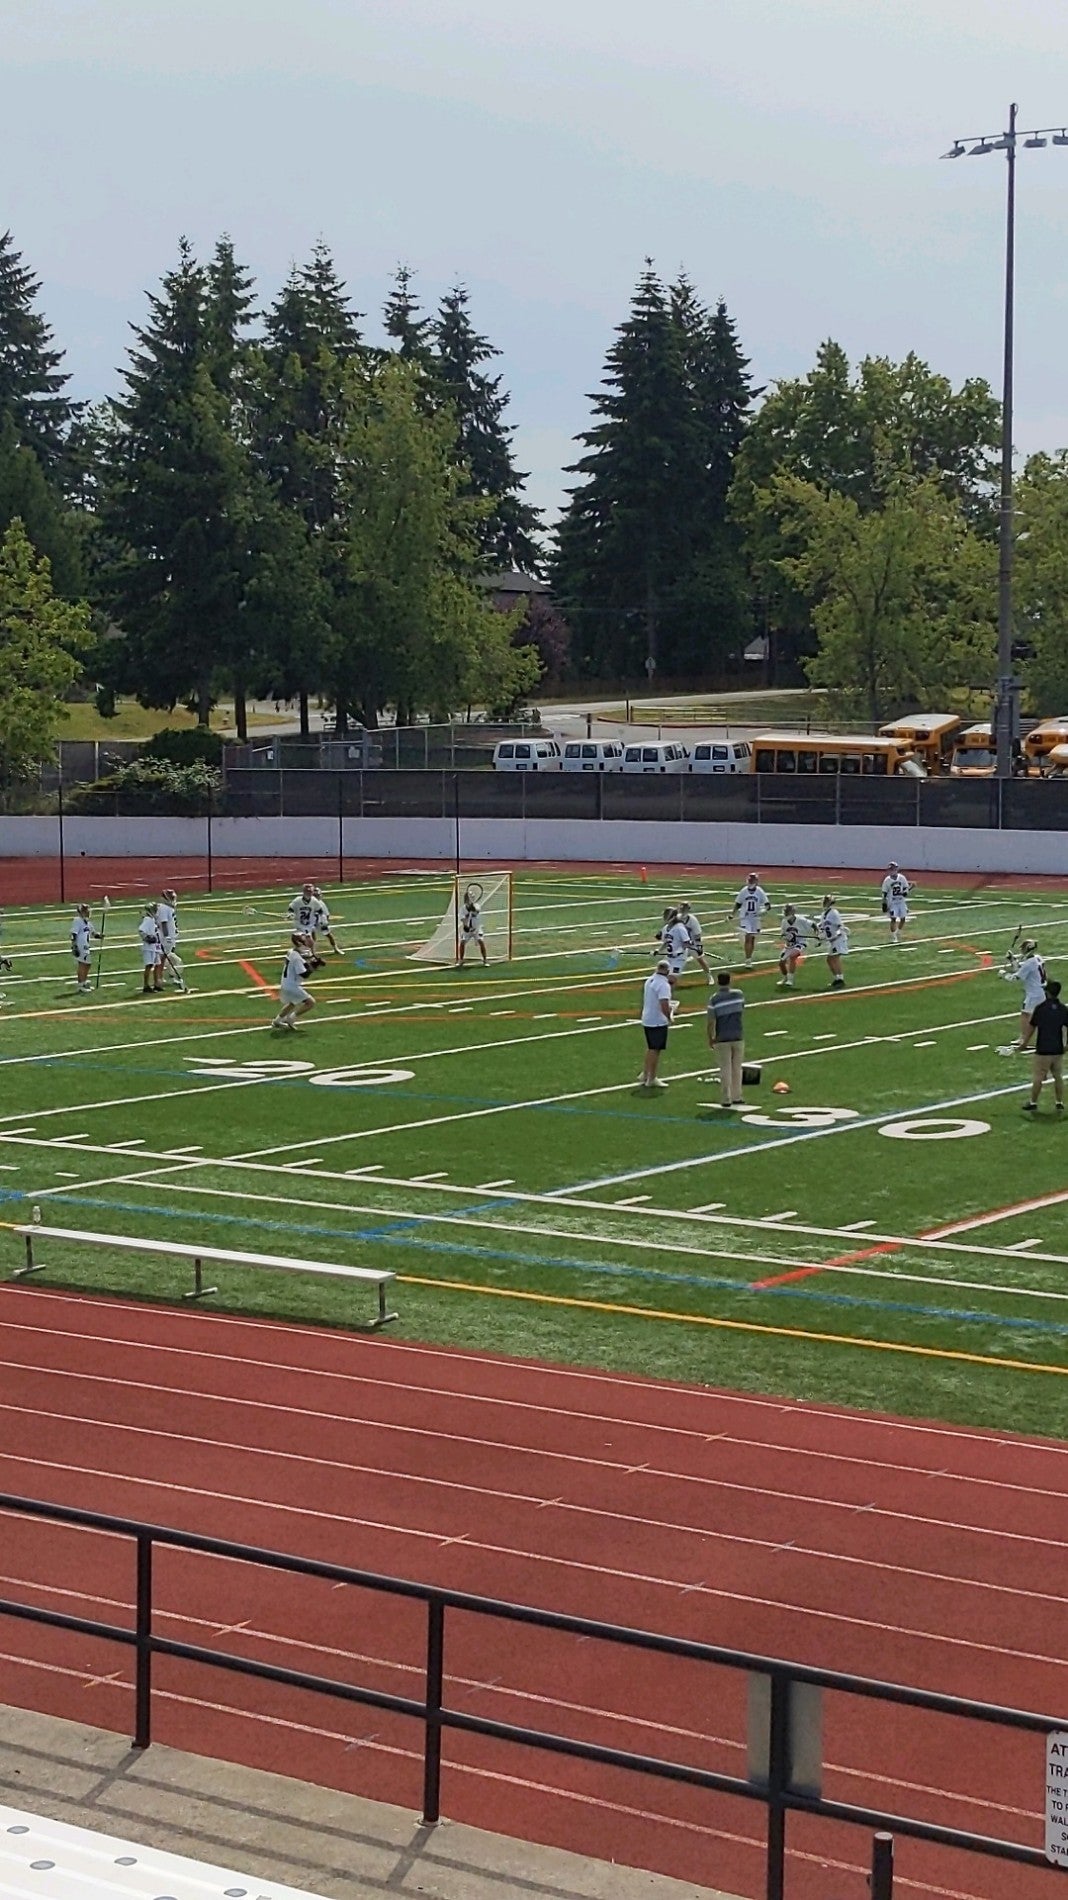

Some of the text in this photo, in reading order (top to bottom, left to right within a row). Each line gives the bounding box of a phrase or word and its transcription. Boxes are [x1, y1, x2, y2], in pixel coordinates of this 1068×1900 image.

[187, 1059, 416, 1087] 20
[741, 1106, 992, 1140] 30
[1046, 1784, 1061, 1797] THE
[1052, 1799, 1063, 1811] TO
